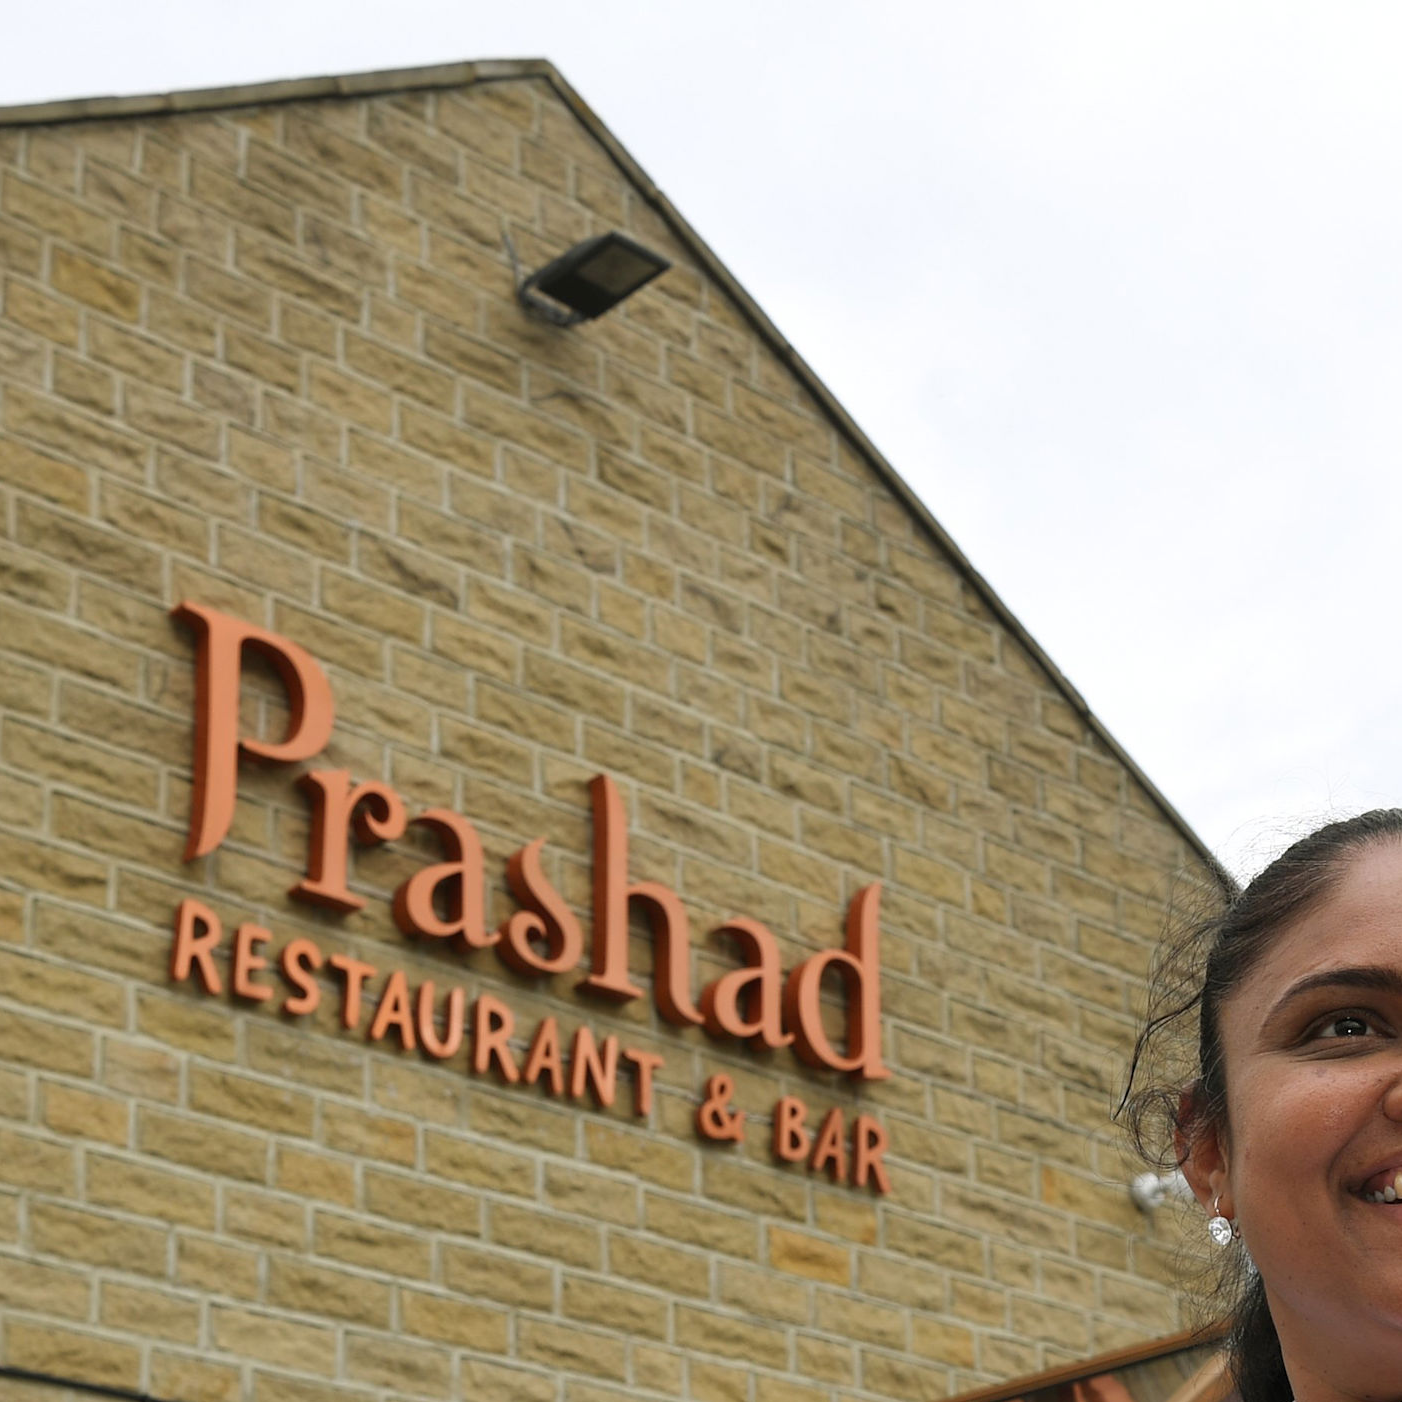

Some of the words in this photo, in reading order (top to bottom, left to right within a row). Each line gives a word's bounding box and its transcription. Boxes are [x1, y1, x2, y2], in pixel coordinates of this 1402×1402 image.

[170, 598, 894, 1080] Prashad
[171, 898, 664, 1116] RESTAURANT
[696, 1073, 744, 1142] &
[774, 1095, 890, 1193] BAR
